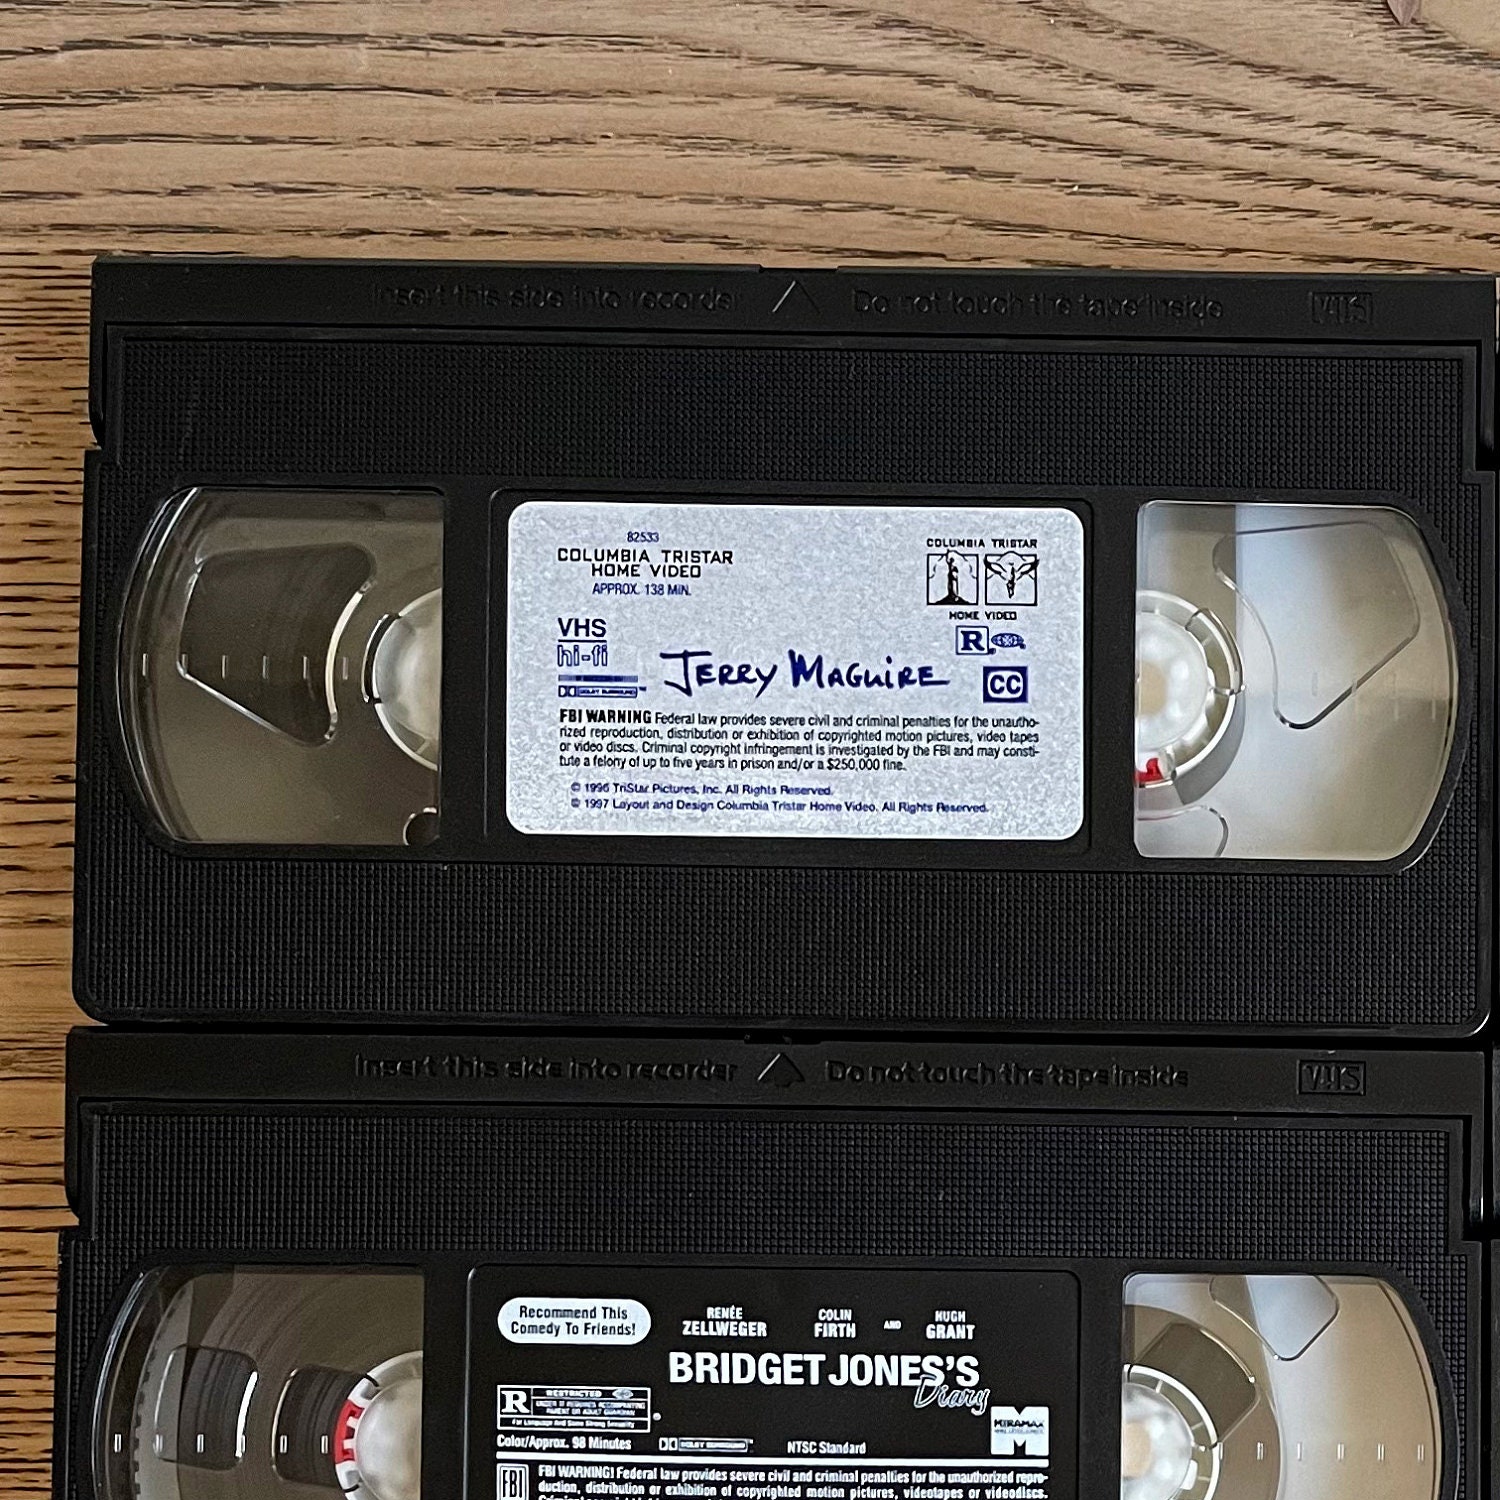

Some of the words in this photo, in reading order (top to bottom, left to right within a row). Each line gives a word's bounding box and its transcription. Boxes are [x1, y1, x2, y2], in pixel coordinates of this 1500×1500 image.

[626, 530, 659, 543] 82533
[926, 538, 985, 548] COLUMBIA
[990, 538, 1037, 548] TRISTAR
[557, 548, 650, 563] COLUMBIA
[661, 549, 733, 565] TRISTAR
[591, 563, 640, 577] HOME
[649, 564, 701, 578] VIDEO
[592, 582, 640, 595] APPROX.
[644, 582, 664, 596] 138
[667, 583, 691, 596] MIN.
[948, 610, 980, 620] HOME
[984, 610, 1017, 620] VIDEO
[557, 617, 607, 638] VHS
[960, 630, 985, 651] R
[557, 644, 608, 666] hi-fi
[988, 672, 1023, 697] CC
[559, 708, 583, 724] FBI
[585, 708, 652, 725] WARNING
[654, 711, 695, 725] Federal
[697, 712, 717, 725] law
[720, 712, 766, 728] provides
[769, 716, 805, 729] severe
[807, 713, 829, 726] civil
[832, 714, 853, 727] and
[855, 713, 899, 727] criminal
[902, 715, 951, 730] penalties
[953, 715, 969, 728] for
[971, 715, 988, 728] the
[990, 716, 1040, 730] unautho-
[518, 1305, 596, 1320] Recommend
[601, 1306, 627, 1320] This
[706, 1305, 742, 1319] RENÉE
[818, 1309, 852, 1322] COLIN
[934, 1309, 965, 1323] HUGH
[510, 1322, 560, 1338] Comedy
[565, 1321, 579, 1335] To
[583, 1322, 635, 1335] Friends!
[682, 1321, 767, 1337] ZELLWEGER
[814, 1321, 856, 1338] FIRTH
[926, 1323, 975, 1340] GRANT
[668, 1351, 826, 1385] BRIDGET
[828, 1353, 980, 1387] JONES'S
[500, 1389, 530, 1416] R
[913, 1374, 991, 1416] Diary
[496, 1434, 569, 1450] Color/Approx.
[571, 1435, 586, 1449] 98
[588, 1435, 631, 1450] Minutes
[787, 1440, 817, 1454] NTSC
[818, 1440, 866, 1454] Standard
[502, 1468, 522, 1498] FBI
